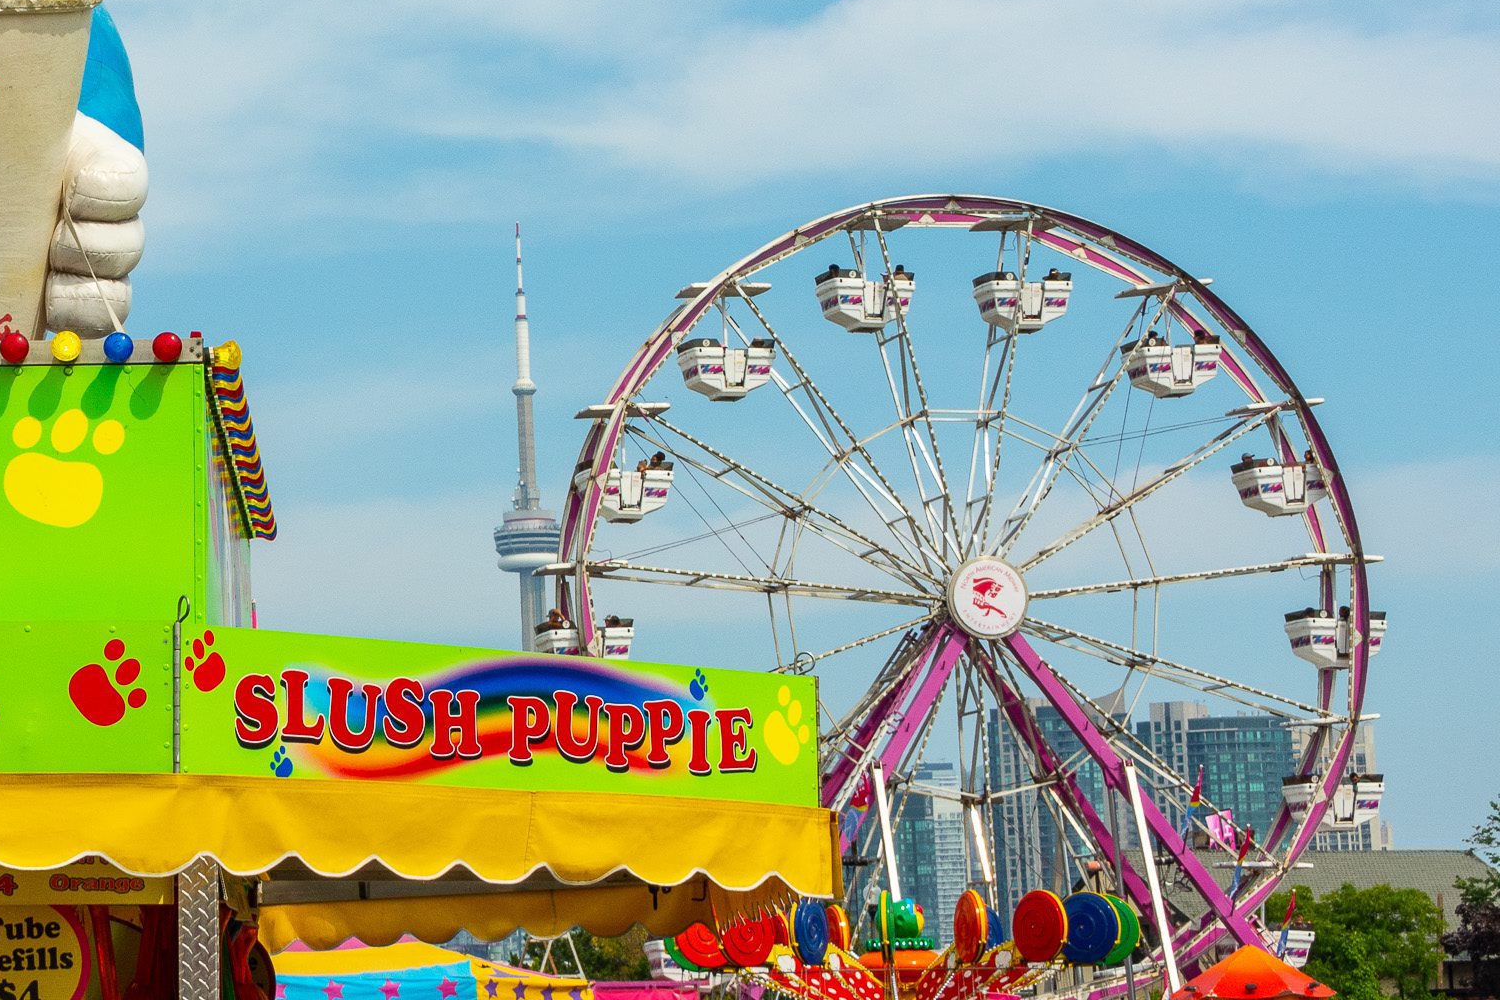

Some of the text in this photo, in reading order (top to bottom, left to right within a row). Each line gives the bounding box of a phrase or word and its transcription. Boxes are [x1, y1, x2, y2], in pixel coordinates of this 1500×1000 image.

[234, 670, 759, 775] SLUSH PUPPIE
[49, 874, 146, 893] Orange
